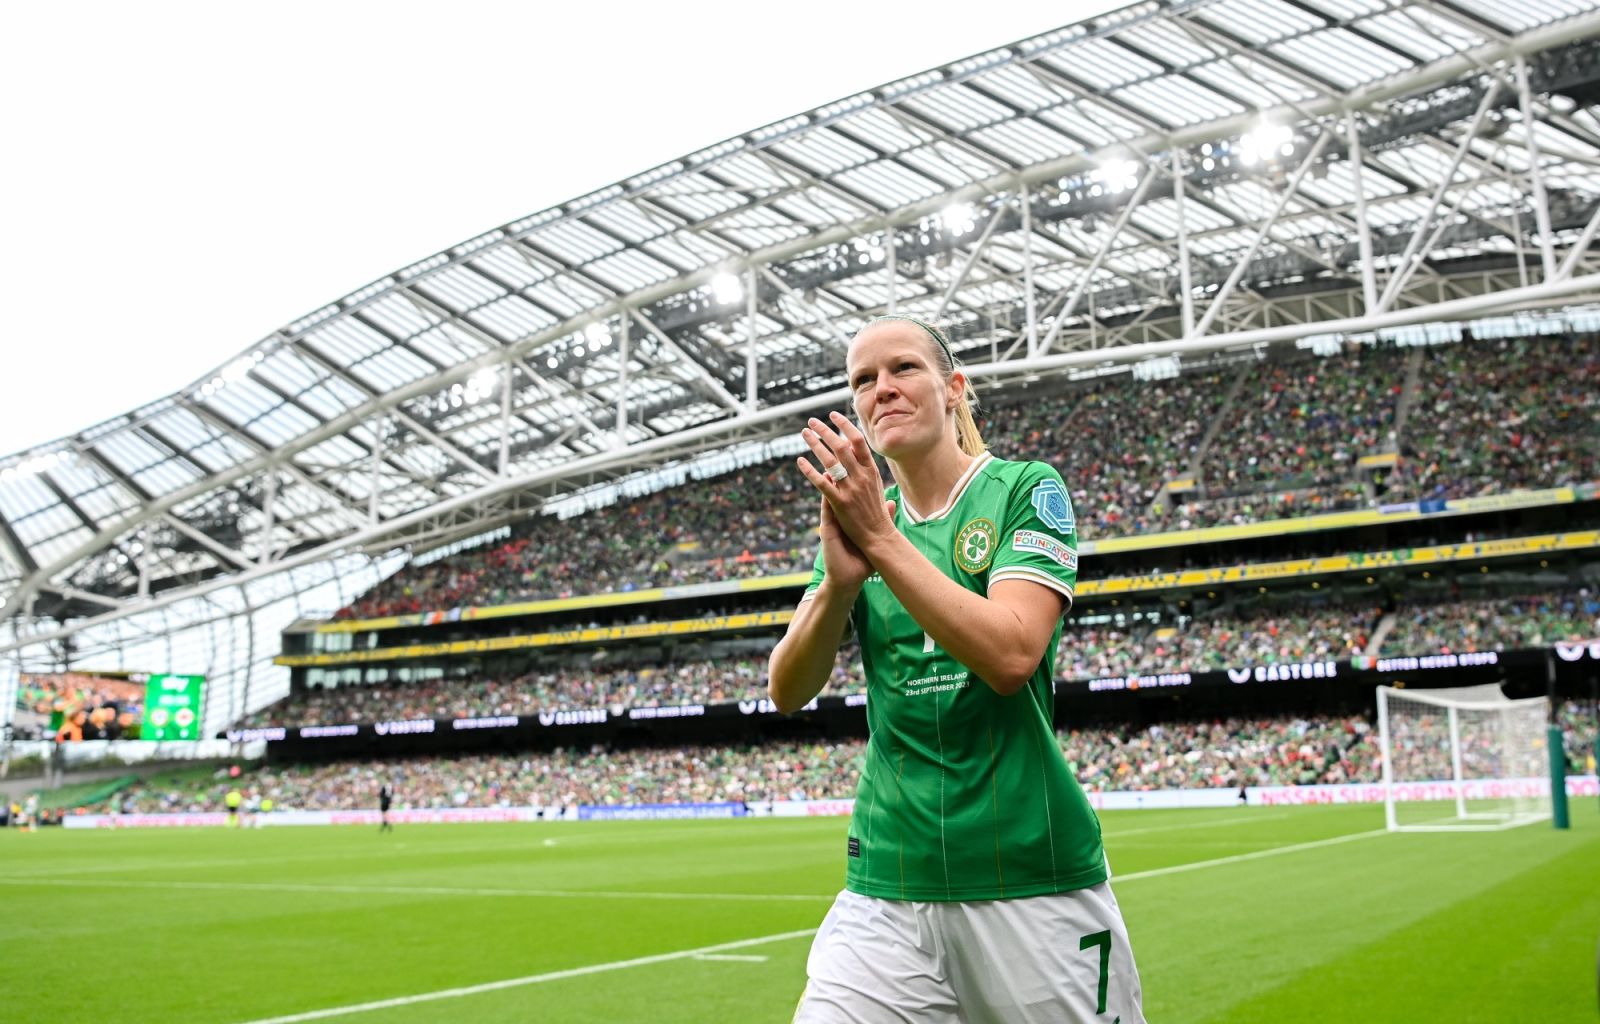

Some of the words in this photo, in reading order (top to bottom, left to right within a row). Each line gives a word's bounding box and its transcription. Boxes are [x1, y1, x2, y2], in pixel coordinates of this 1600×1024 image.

[1015, 536, 1077, 564] FOUNDATION
[907, 676, 939, 687] NORTHERN
[940, 672, 968, 682] IRELAND
[1255, 661, 1337, 682] CASTORE
[905, 689, 920, 697] 23rd
[920, 684, 955, 695] SEPTEMBER
[1080, 929, 1111, 1015] 7
